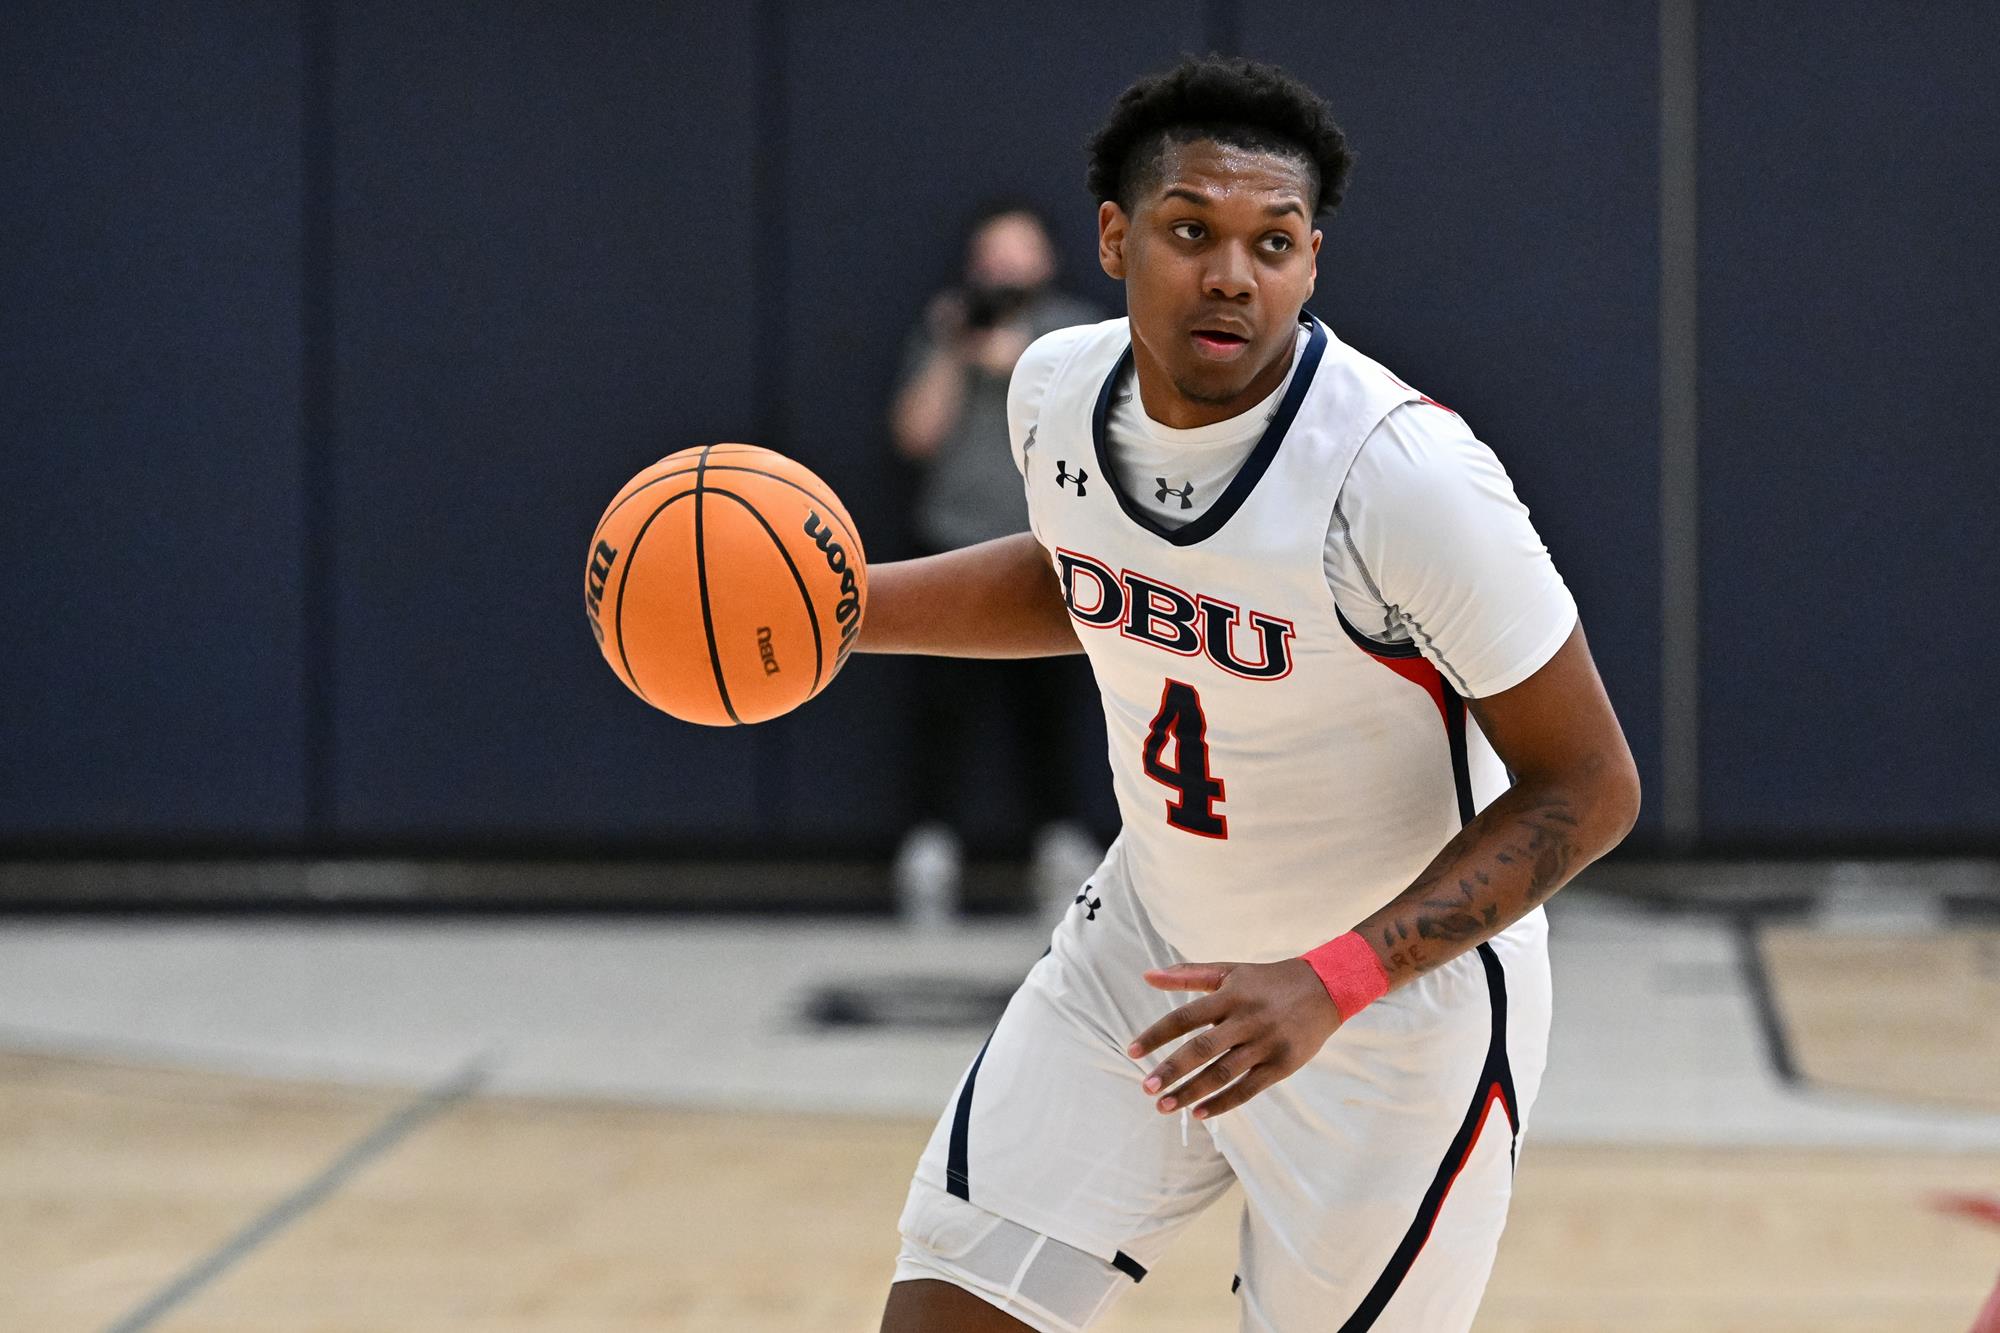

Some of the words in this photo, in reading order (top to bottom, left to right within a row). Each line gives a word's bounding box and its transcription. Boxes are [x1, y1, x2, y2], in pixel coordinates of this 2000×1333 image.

[756, 626, 781, 677] DBU
[1056, 546, 1296, 681] DBU
[1142, 677, 1228, 840] 4
